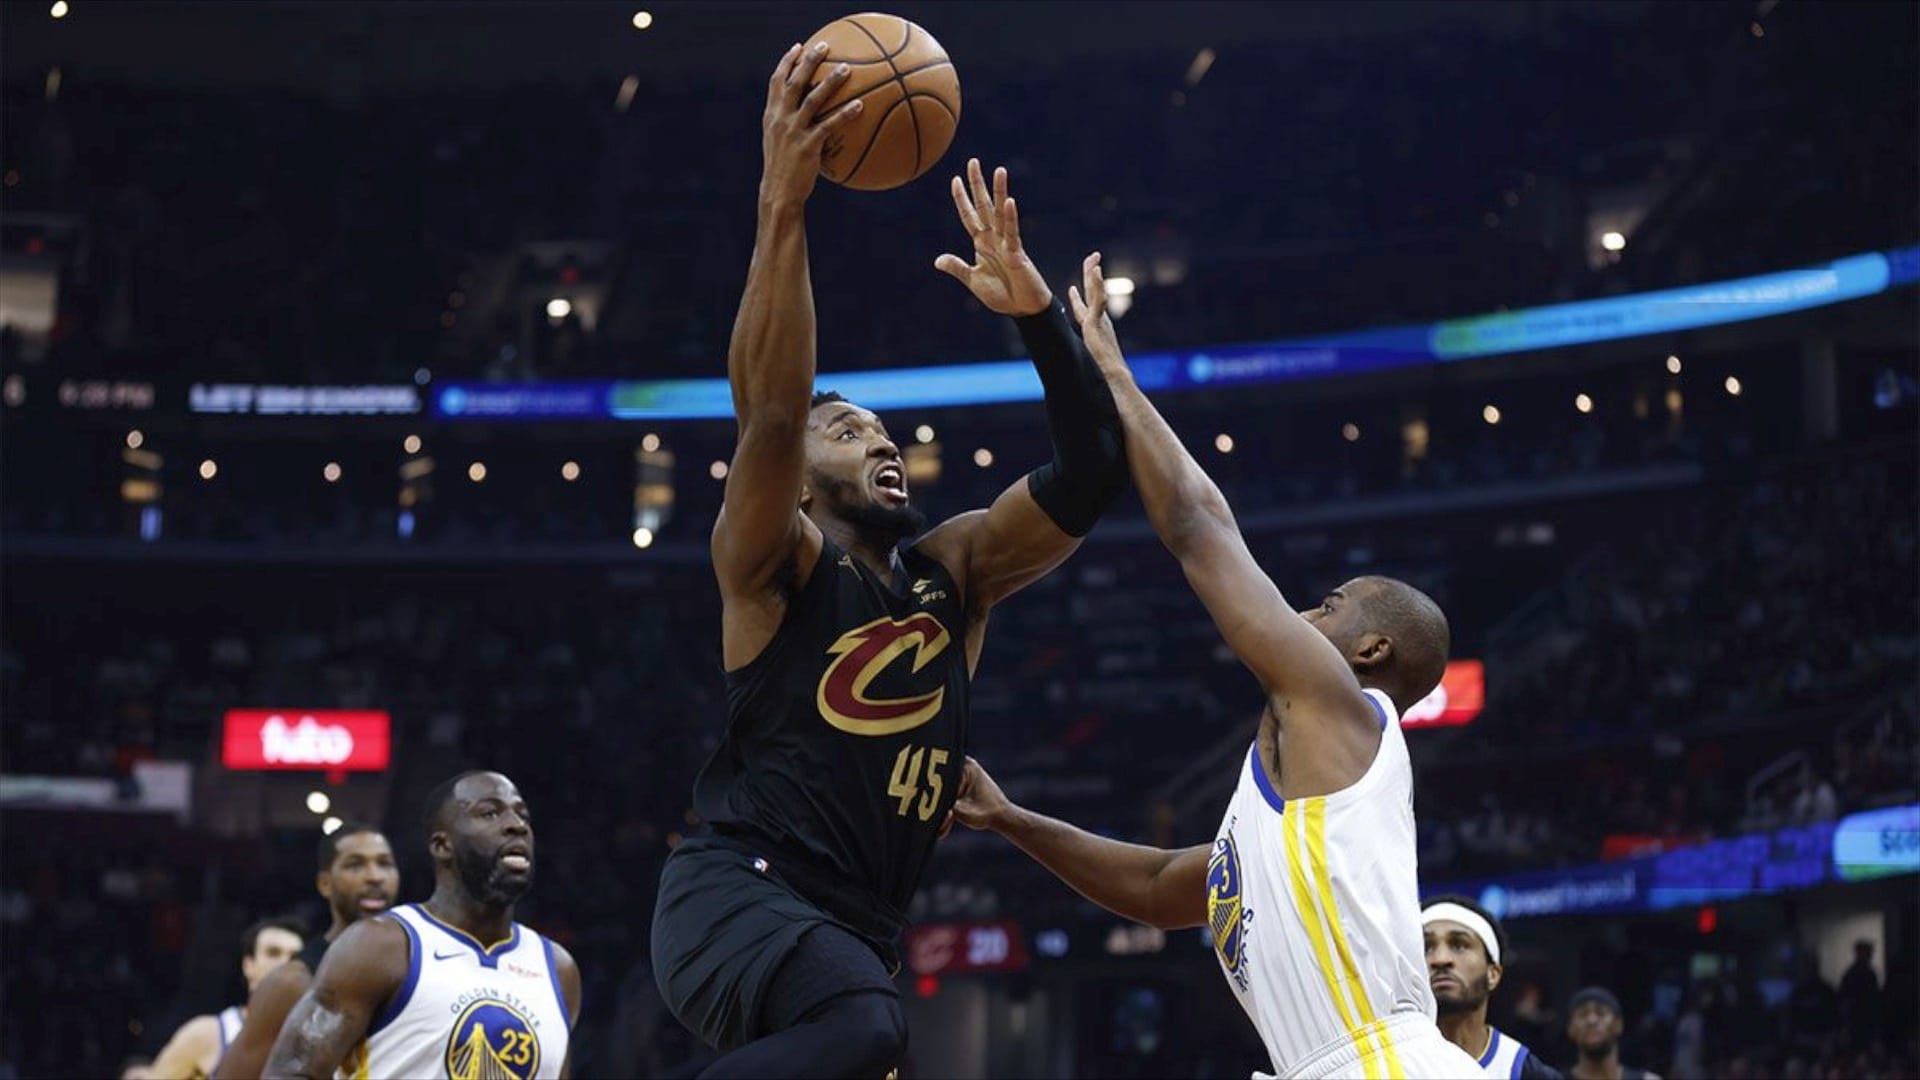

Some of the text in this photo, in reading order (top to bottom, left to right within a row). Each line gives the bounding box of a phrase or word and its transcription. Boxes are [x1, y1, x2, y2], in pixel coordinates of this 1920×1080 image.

[888, 743, 949, 821] 45
[450, 986, 541, 1028] GOLDEN STATE
[499, 1028, 533, 1066] 23
